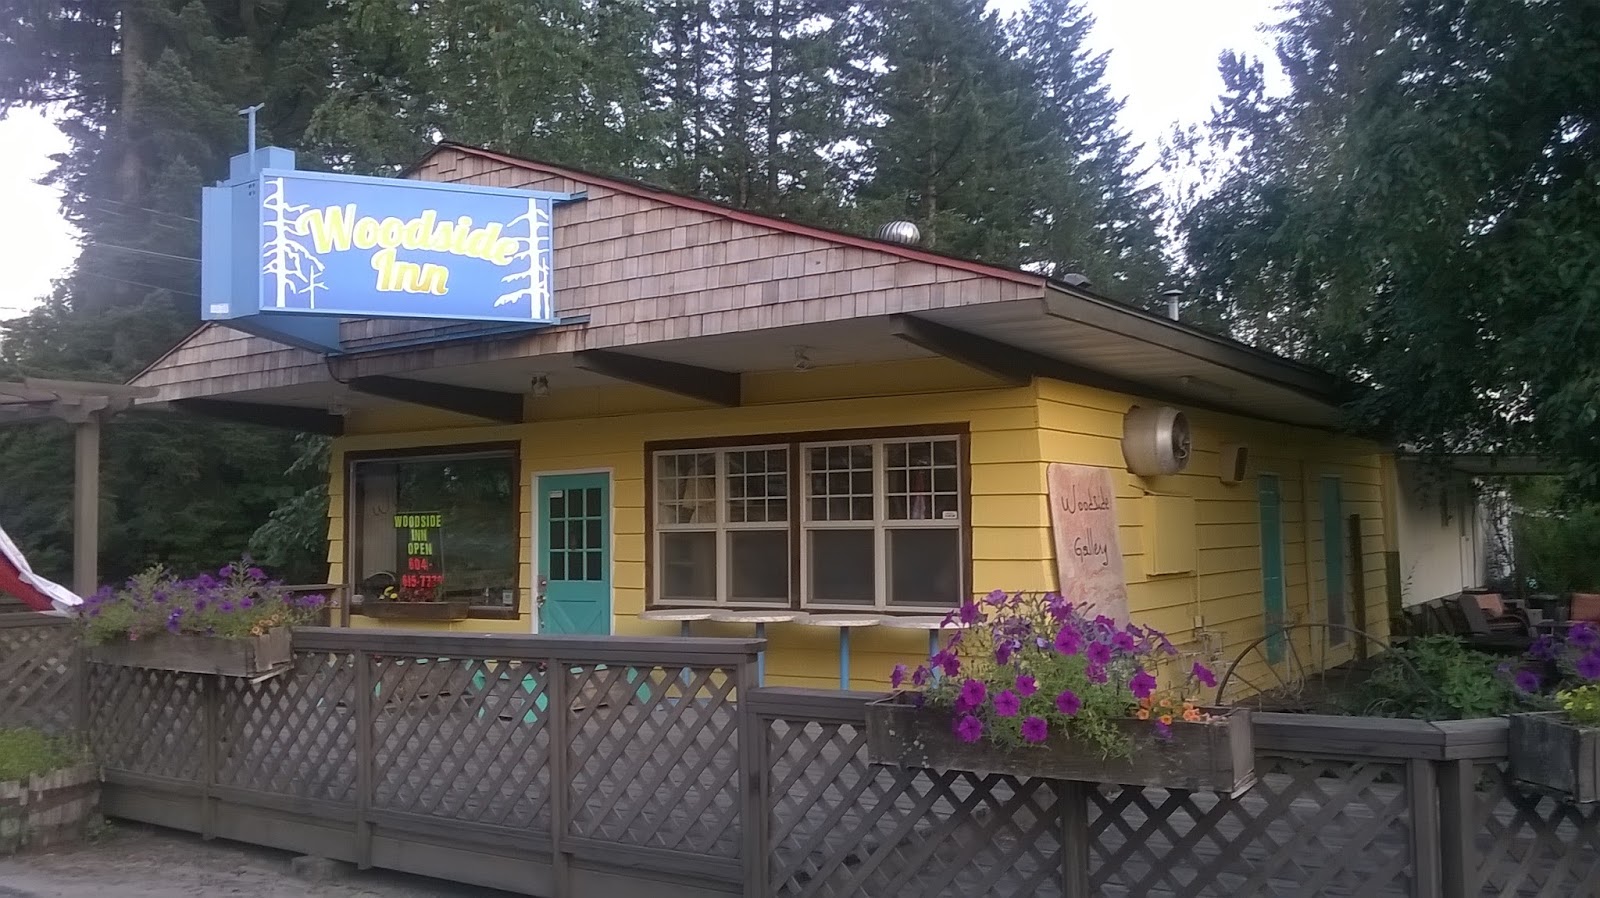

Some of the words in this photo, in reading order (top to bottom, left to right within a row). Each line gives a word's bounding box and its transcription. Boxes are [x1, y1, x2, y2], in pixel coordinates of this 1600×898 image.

[299, 203, 520, 265] Woodside
[371, 249, 449, 295] Inn
[1061, 484, 1110, 514] Woodside
[394, 515, 441, 528] WOODSIDE
[411, 529, 427, 541] INN
[407, 543, 432, 555] OPEN
[1074, 528, 1109, 566] Gallery
